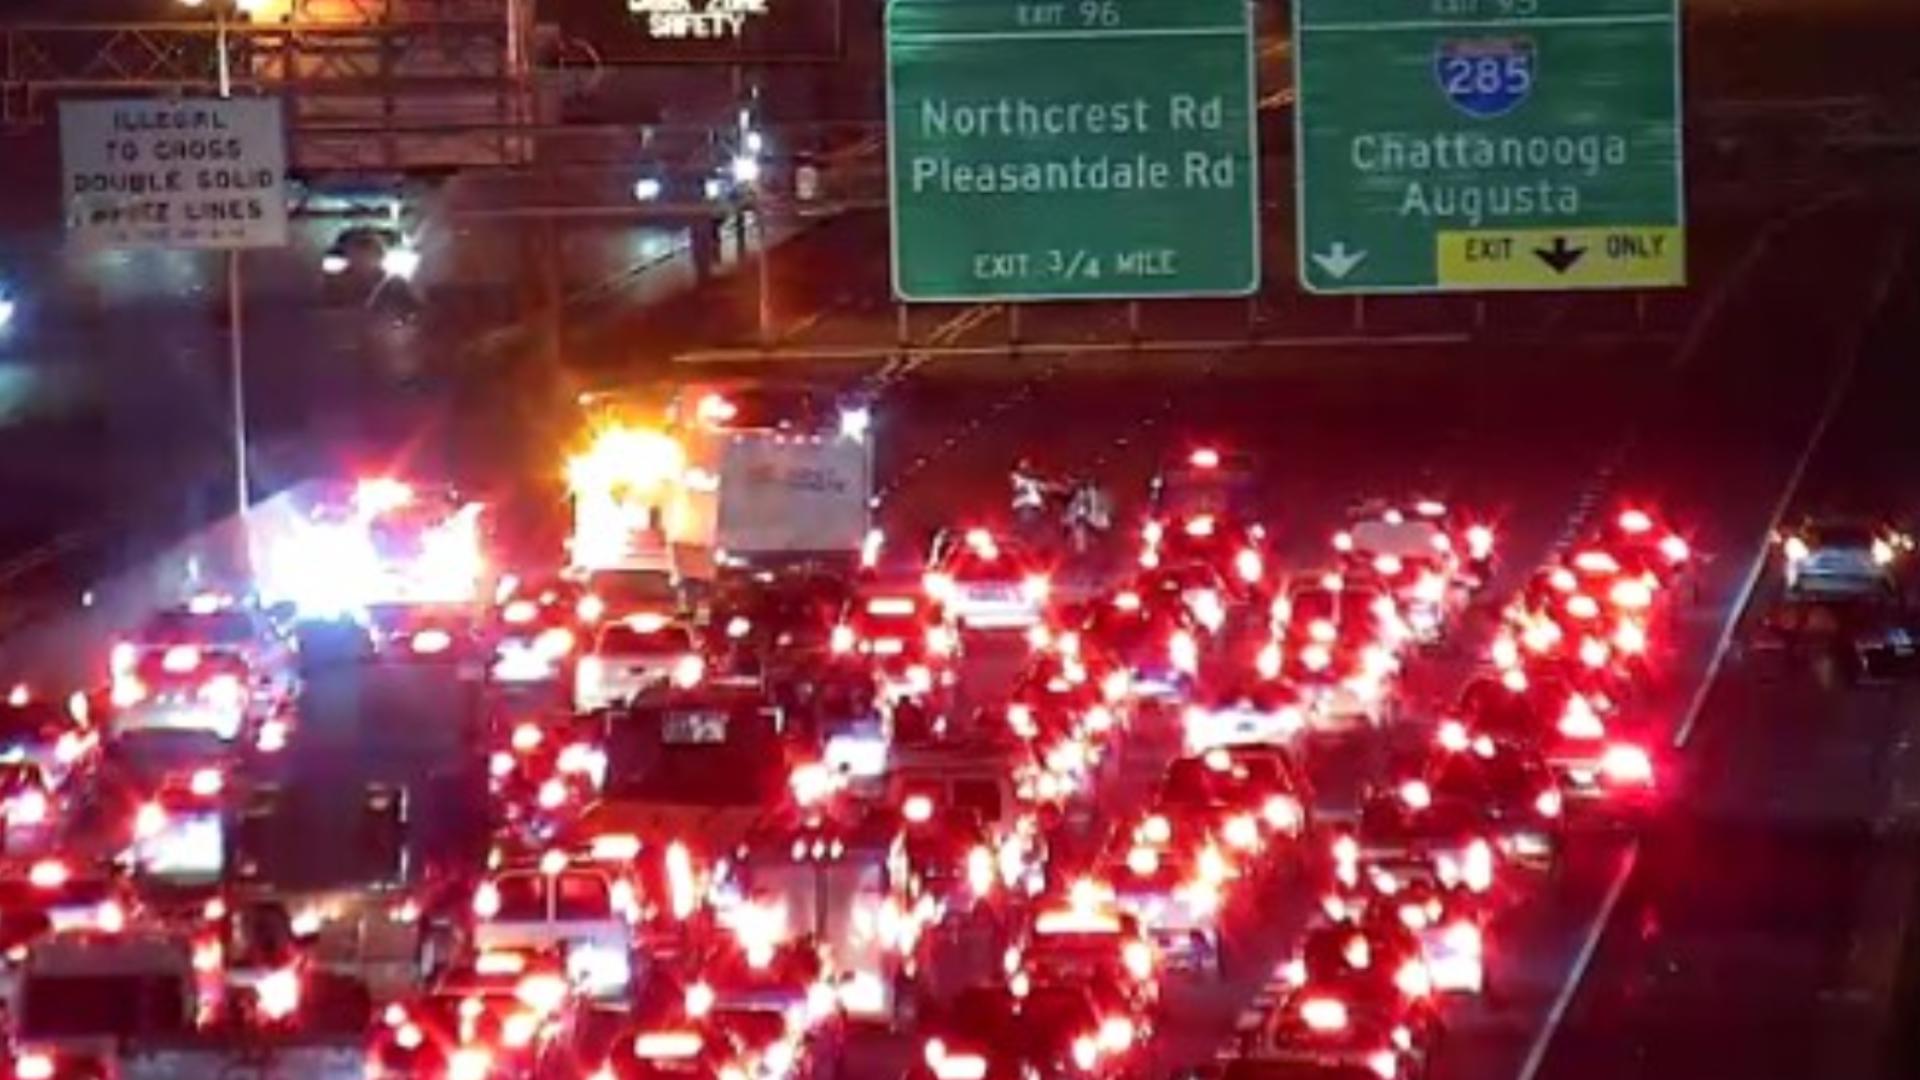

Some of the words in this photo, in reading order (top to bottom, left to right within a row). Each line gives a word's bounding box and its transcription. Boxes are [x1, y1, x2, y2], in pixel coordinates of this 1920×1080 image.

[649, 12, 745, 38] SAFETY
[1079, 0, 1120, 26] 96
[1447, 57, 1530, 95] 285
[113, 111, 227, 130] ILLEGAL
[921, 98, 1150, 136] Northcrest
[1169, 93, 1223, 130] Rd
[106, 139, 139, 161] TO
[153, 138, 242, 161] CROSS
[1351, 132, 1626, 176] Chattanooga
[74, 171, 182, 193] DOUBLE
[197, 169, 273, 189] SOLID
[912, 154, 1168, 193] Pleasantdale
[1185, 151, 1235, 187] Rd
[185, 201, 263, 220] LINES
[1400, 180, 1579, 226] Augusta
[1464, 238, 1512, 261] EXIT
[1605, 234, 1665, 260] ONLY
[974, 254, 1030, 278] EXIT
[1048, 249, 1100, 279] 3/4
[1116, 250, 1177, 275] MILE
